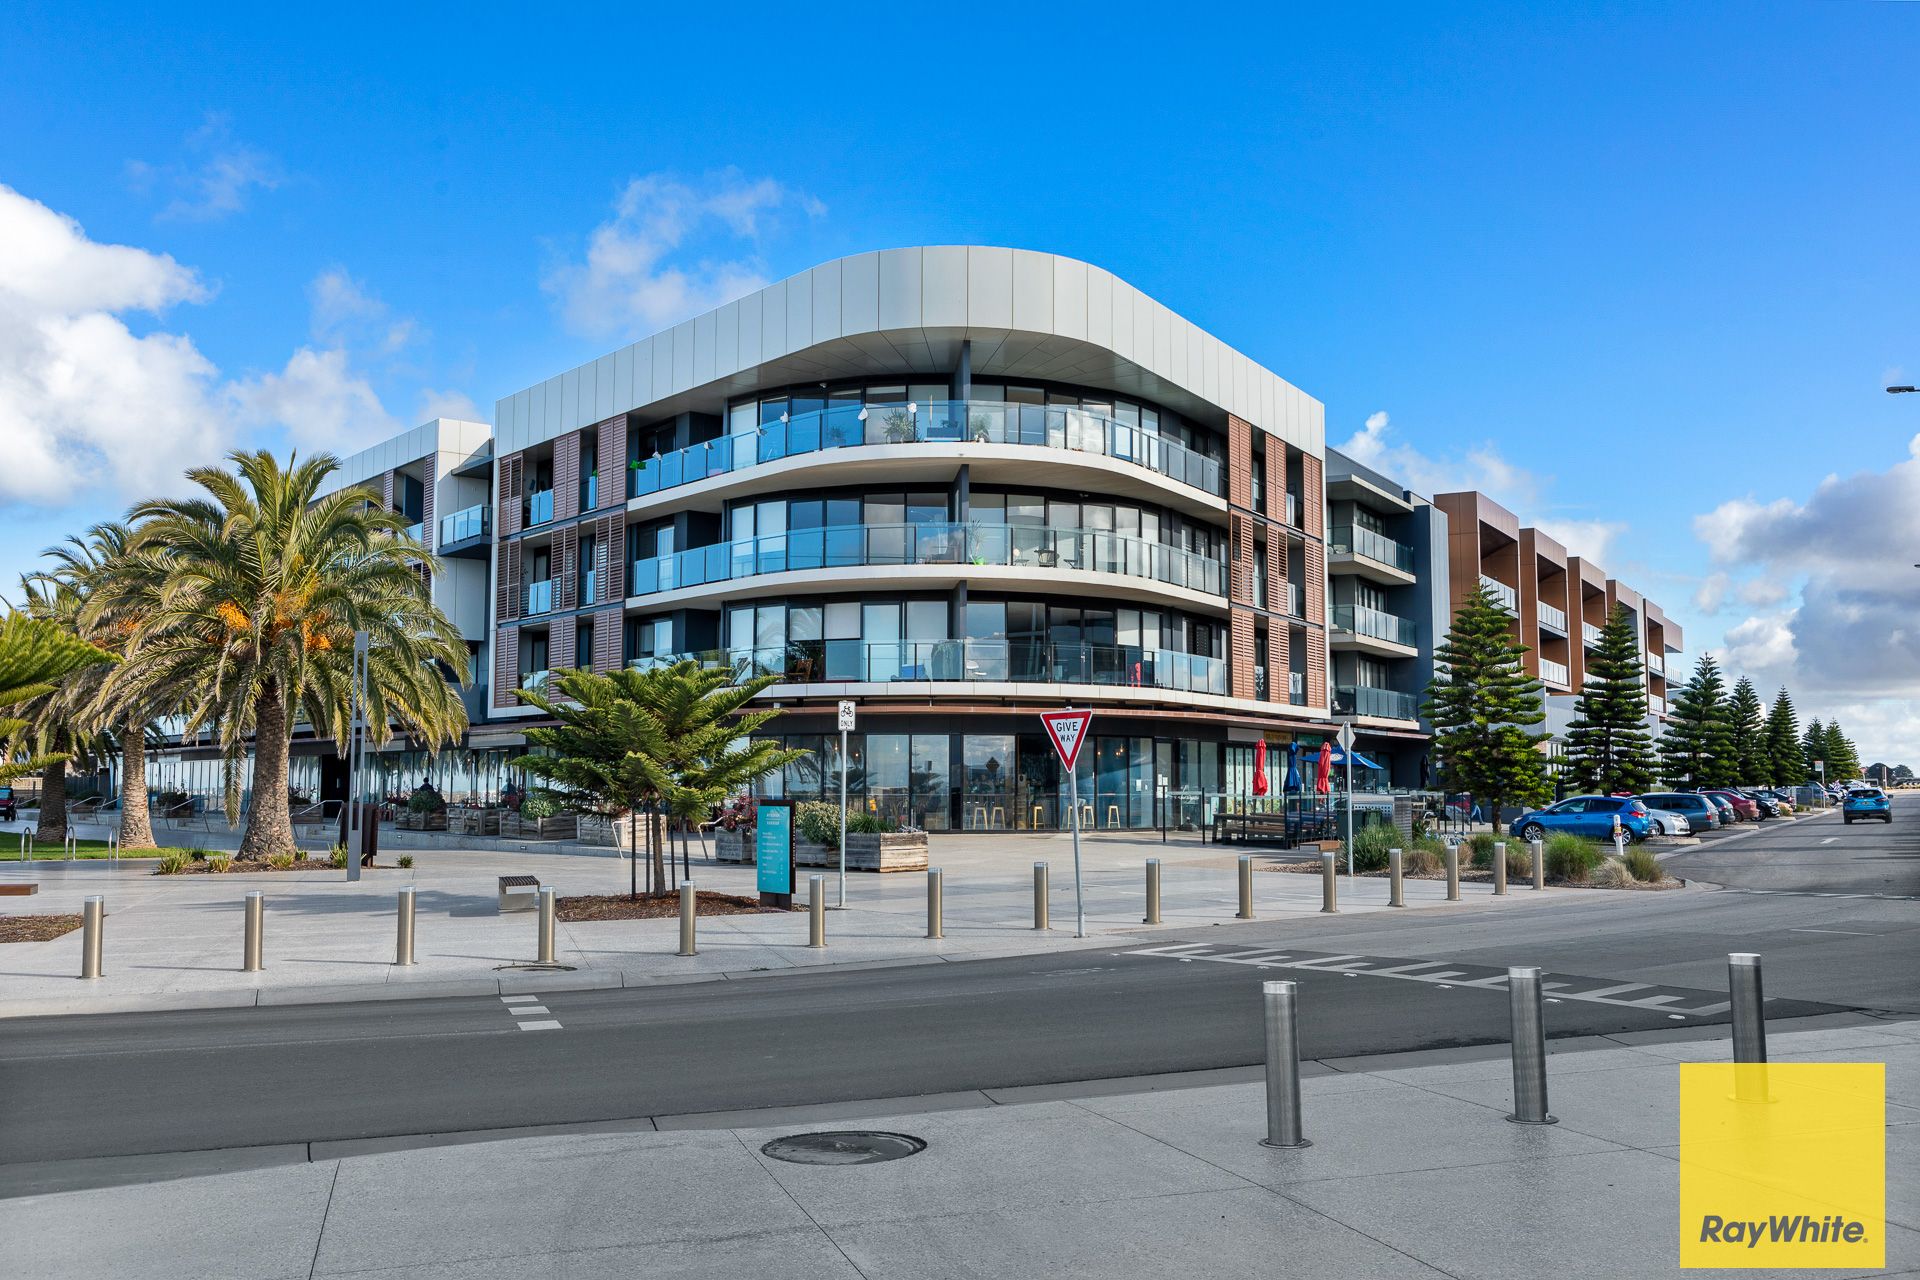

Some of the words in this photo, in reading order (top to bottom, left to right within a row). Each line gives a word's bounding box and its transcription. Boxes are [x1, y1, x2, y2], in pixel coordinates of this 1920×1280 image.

[840, 719, 854, 727] ONLY
[1056, 721, 1079, 732] GIVE
[1060, 733, 1076, 743] WAY
